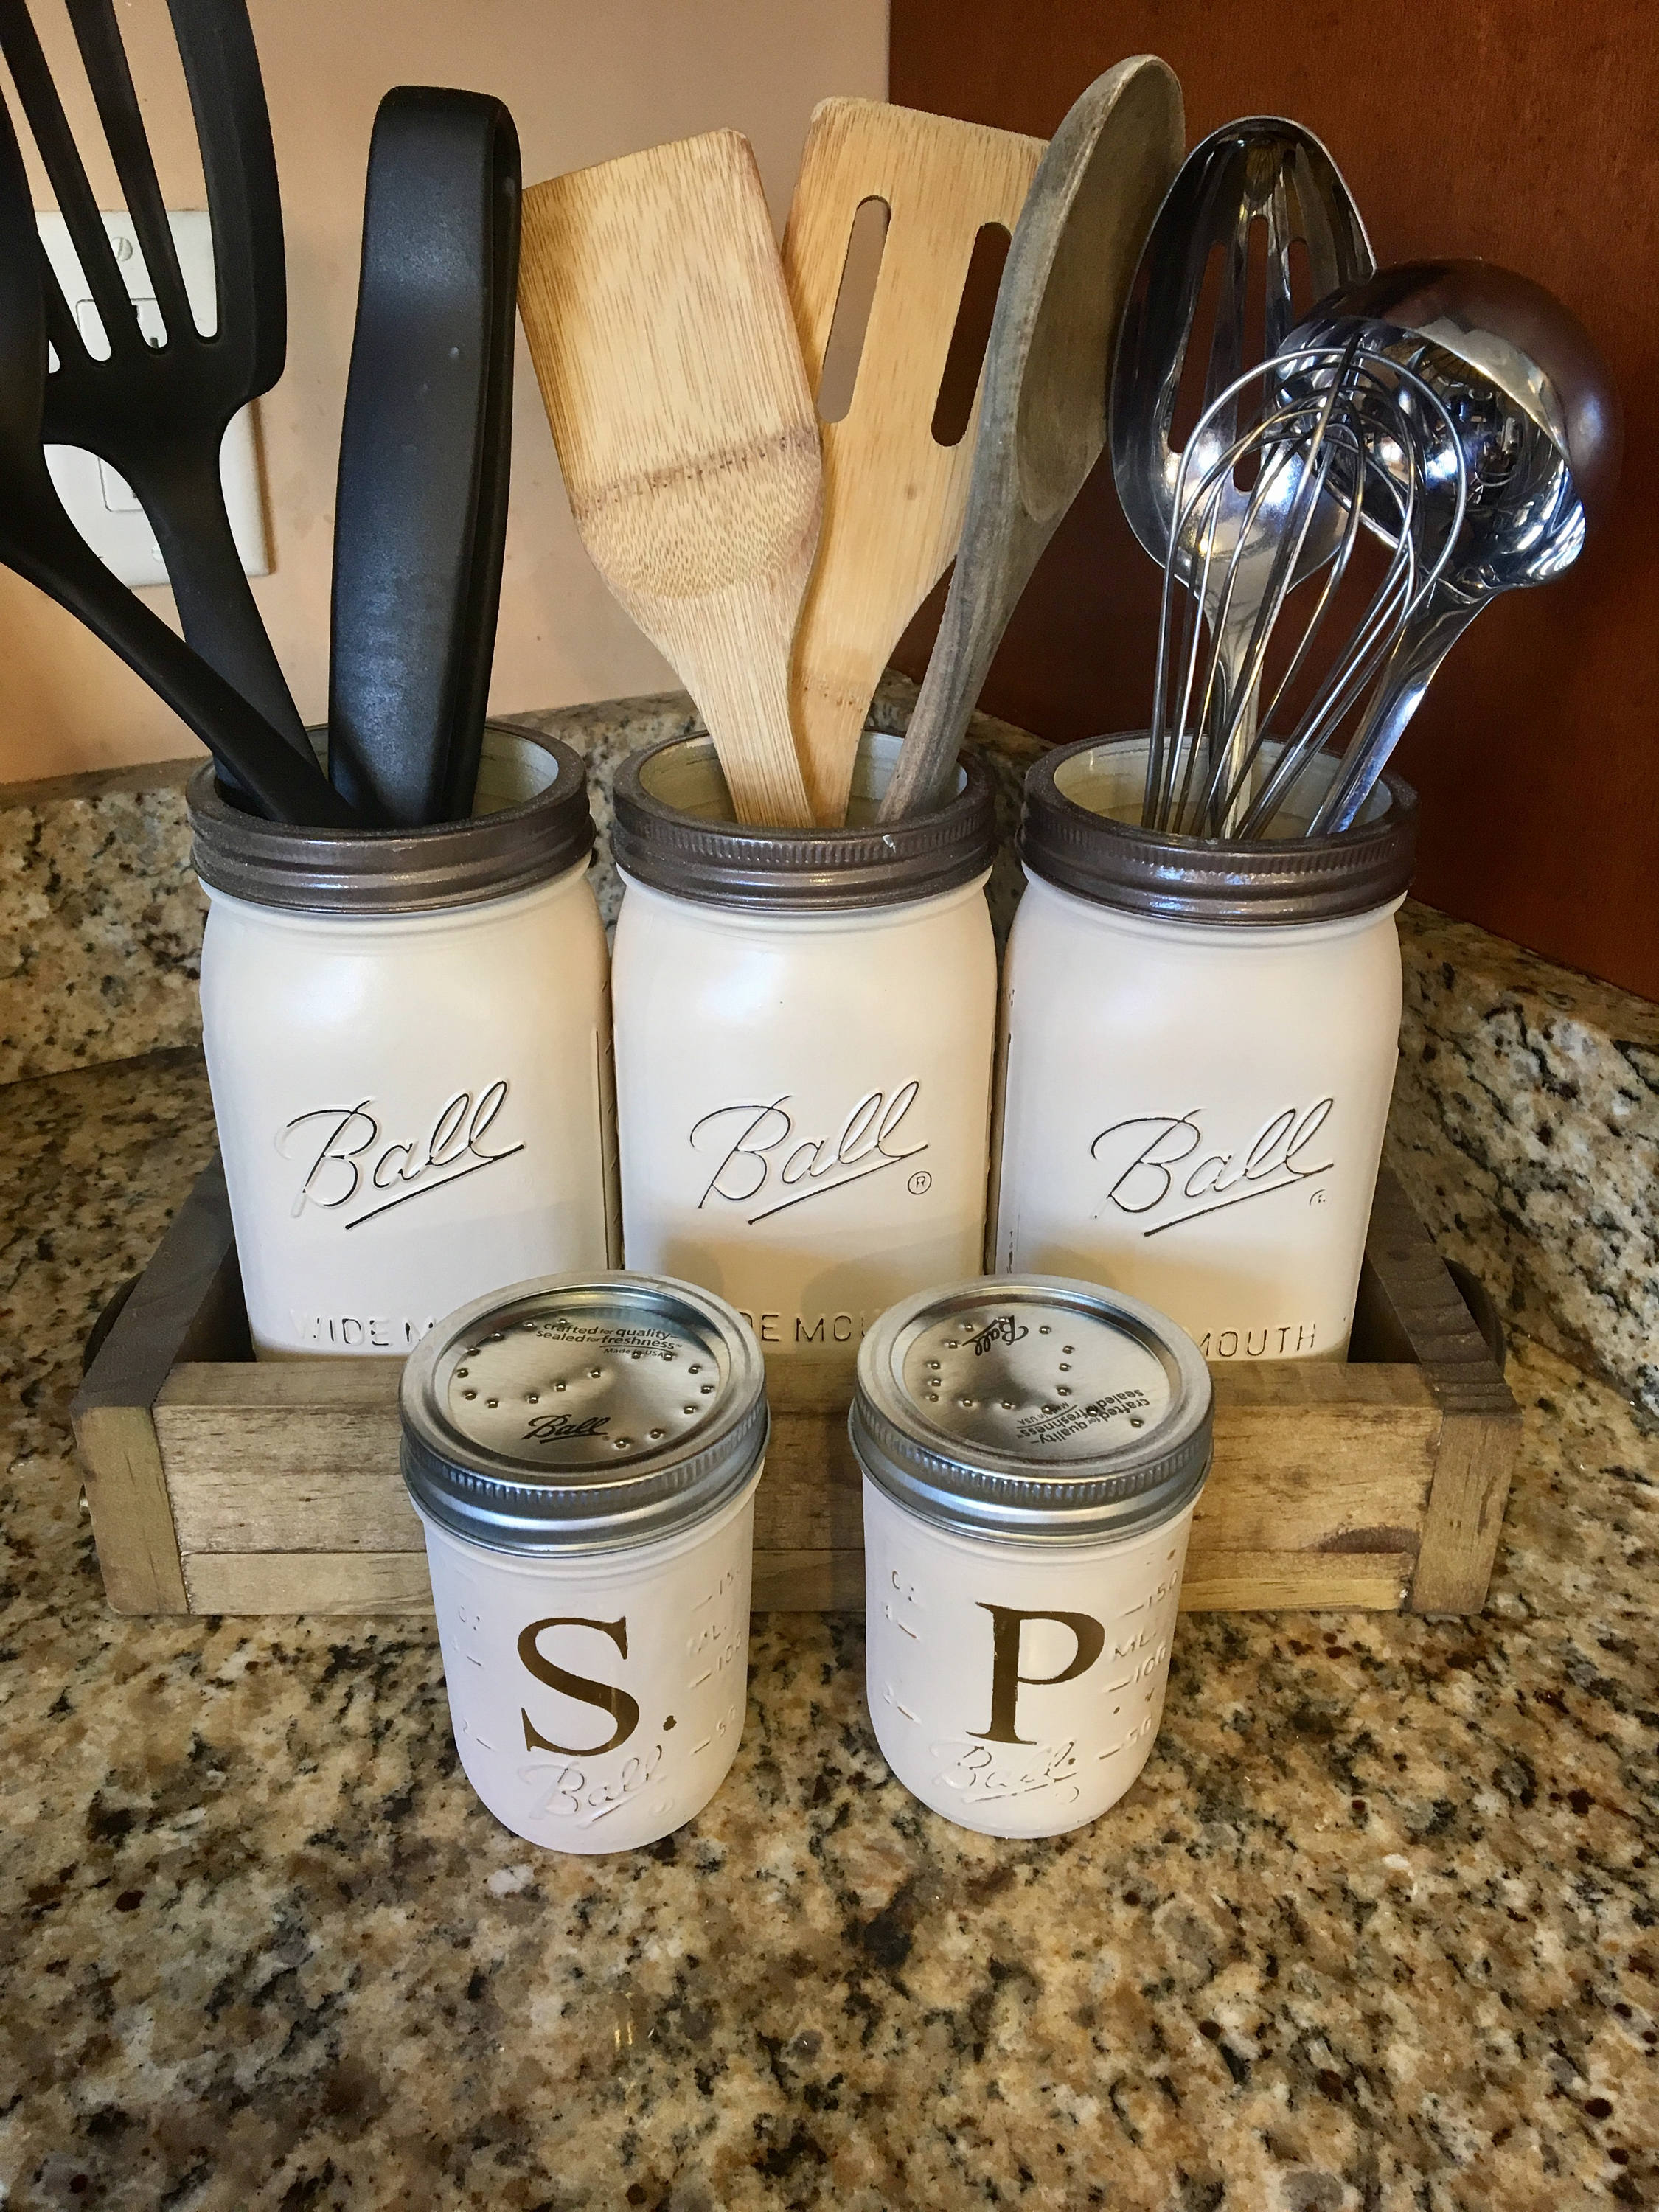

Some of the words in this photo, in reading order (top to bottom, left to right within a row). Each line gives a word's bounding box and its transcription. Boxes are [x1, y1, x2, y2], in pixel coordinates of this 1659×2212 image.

[276, 1080, 525, 1230] Ball
[689, 1080, 929, 1225] Ball
[1090, 1097, 1335, 1237] Ball
[536, 1329, 586, 1343] sealed
[543, 1322, 599, 1335] crafted
[1094, 1389, 1145, 1410] sealed
[1101, 1398, 1150, 1422] crafted
[521, 1413, 611, 1444] Ball
[966, 1601, 1106, 1746] P
